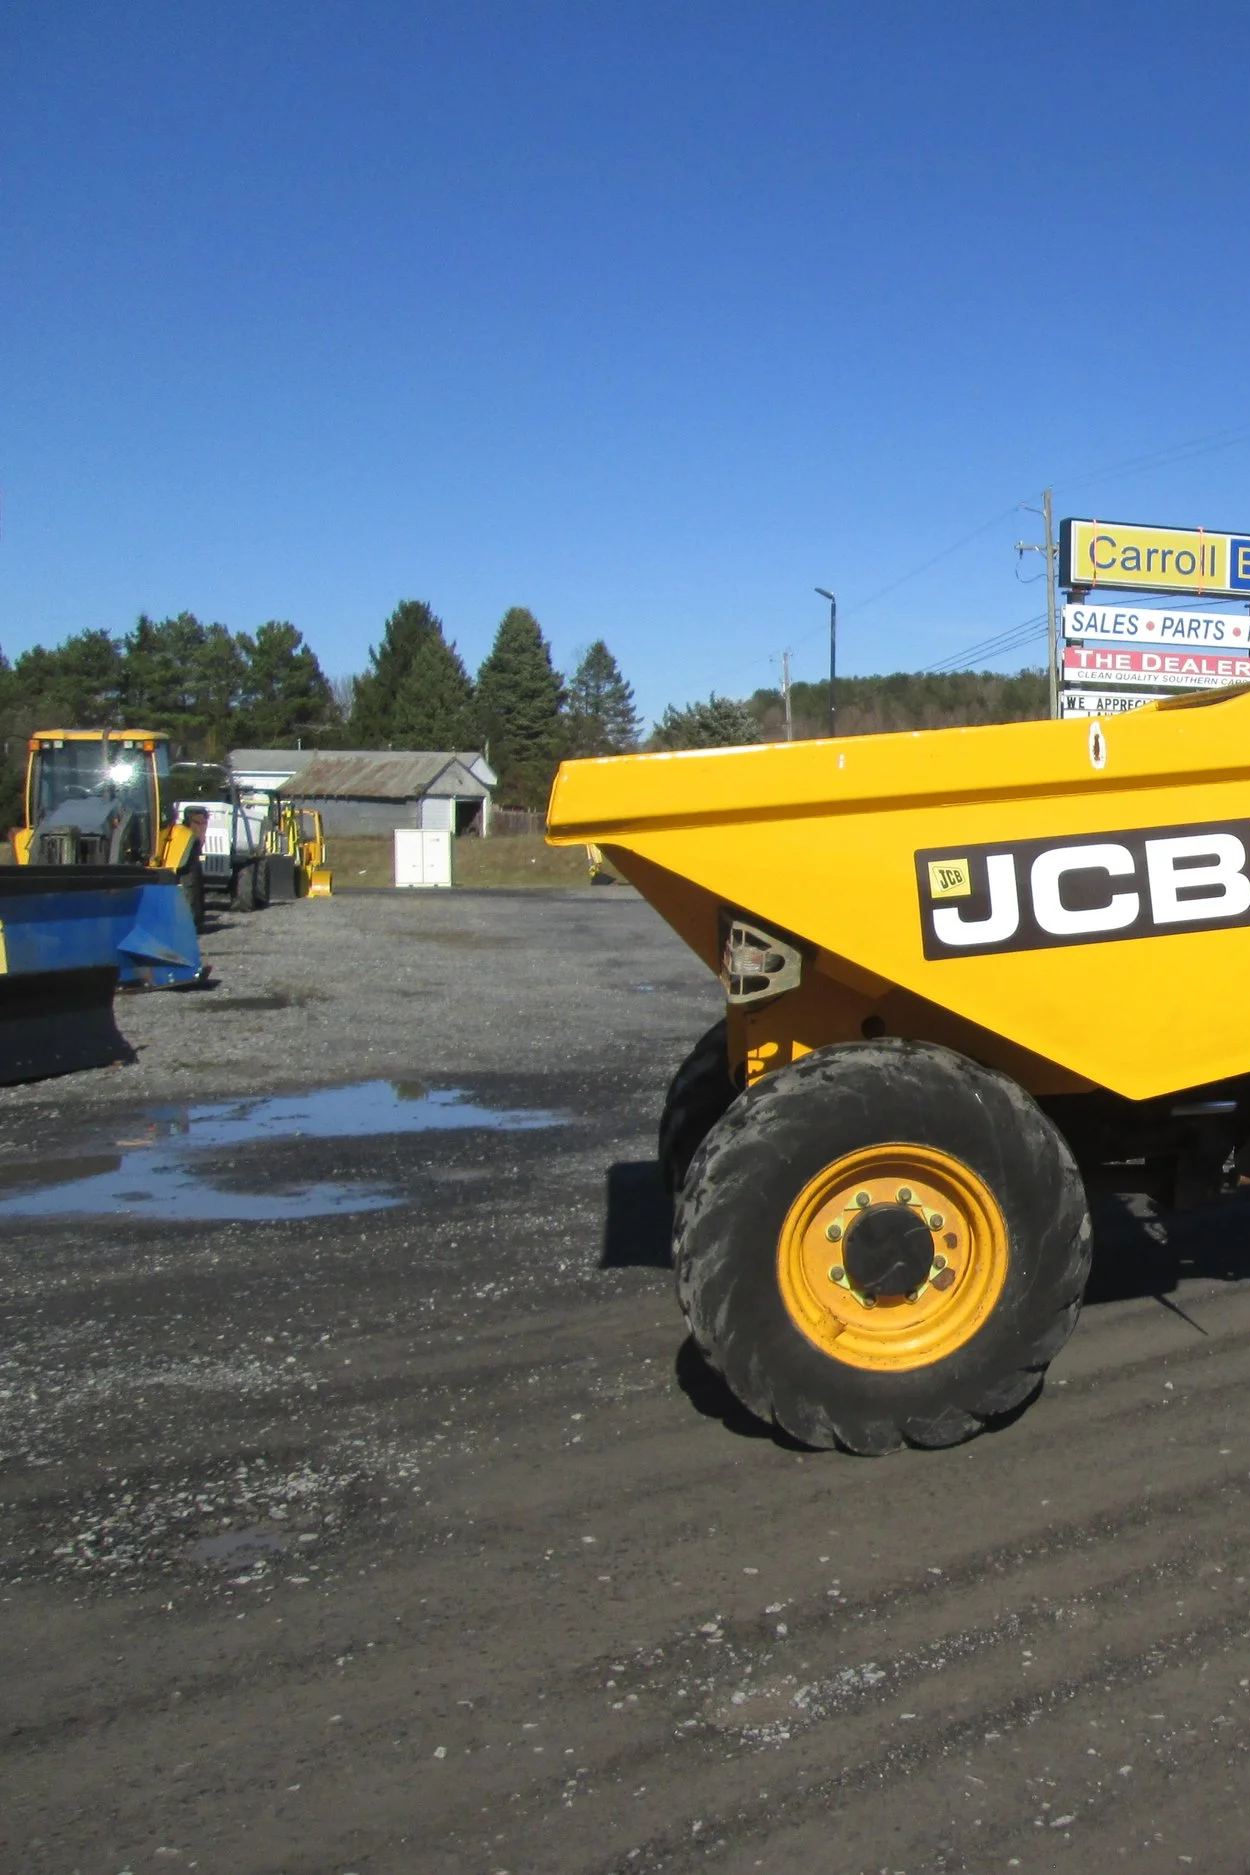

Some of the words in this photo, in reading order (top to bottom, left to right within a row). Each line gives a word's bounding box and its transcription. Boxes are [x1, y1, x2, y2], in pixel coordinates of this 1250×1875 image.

[1089, 535, 1216, 577] Carroll
[1071, 611, 1139, 635] SALES
[1160, 617, 1225, 640] PARTS
[1074, 650, 1131, 670] THE
[1077, 671, 1112, 680] CLEAN
[1115, 672, 1159, 682] QUALITY
[1162, 675, 1219, 685] SOUTHERN
[1067, 697, 1085, 710] WE
[938, 869, 963, 889] JCB
